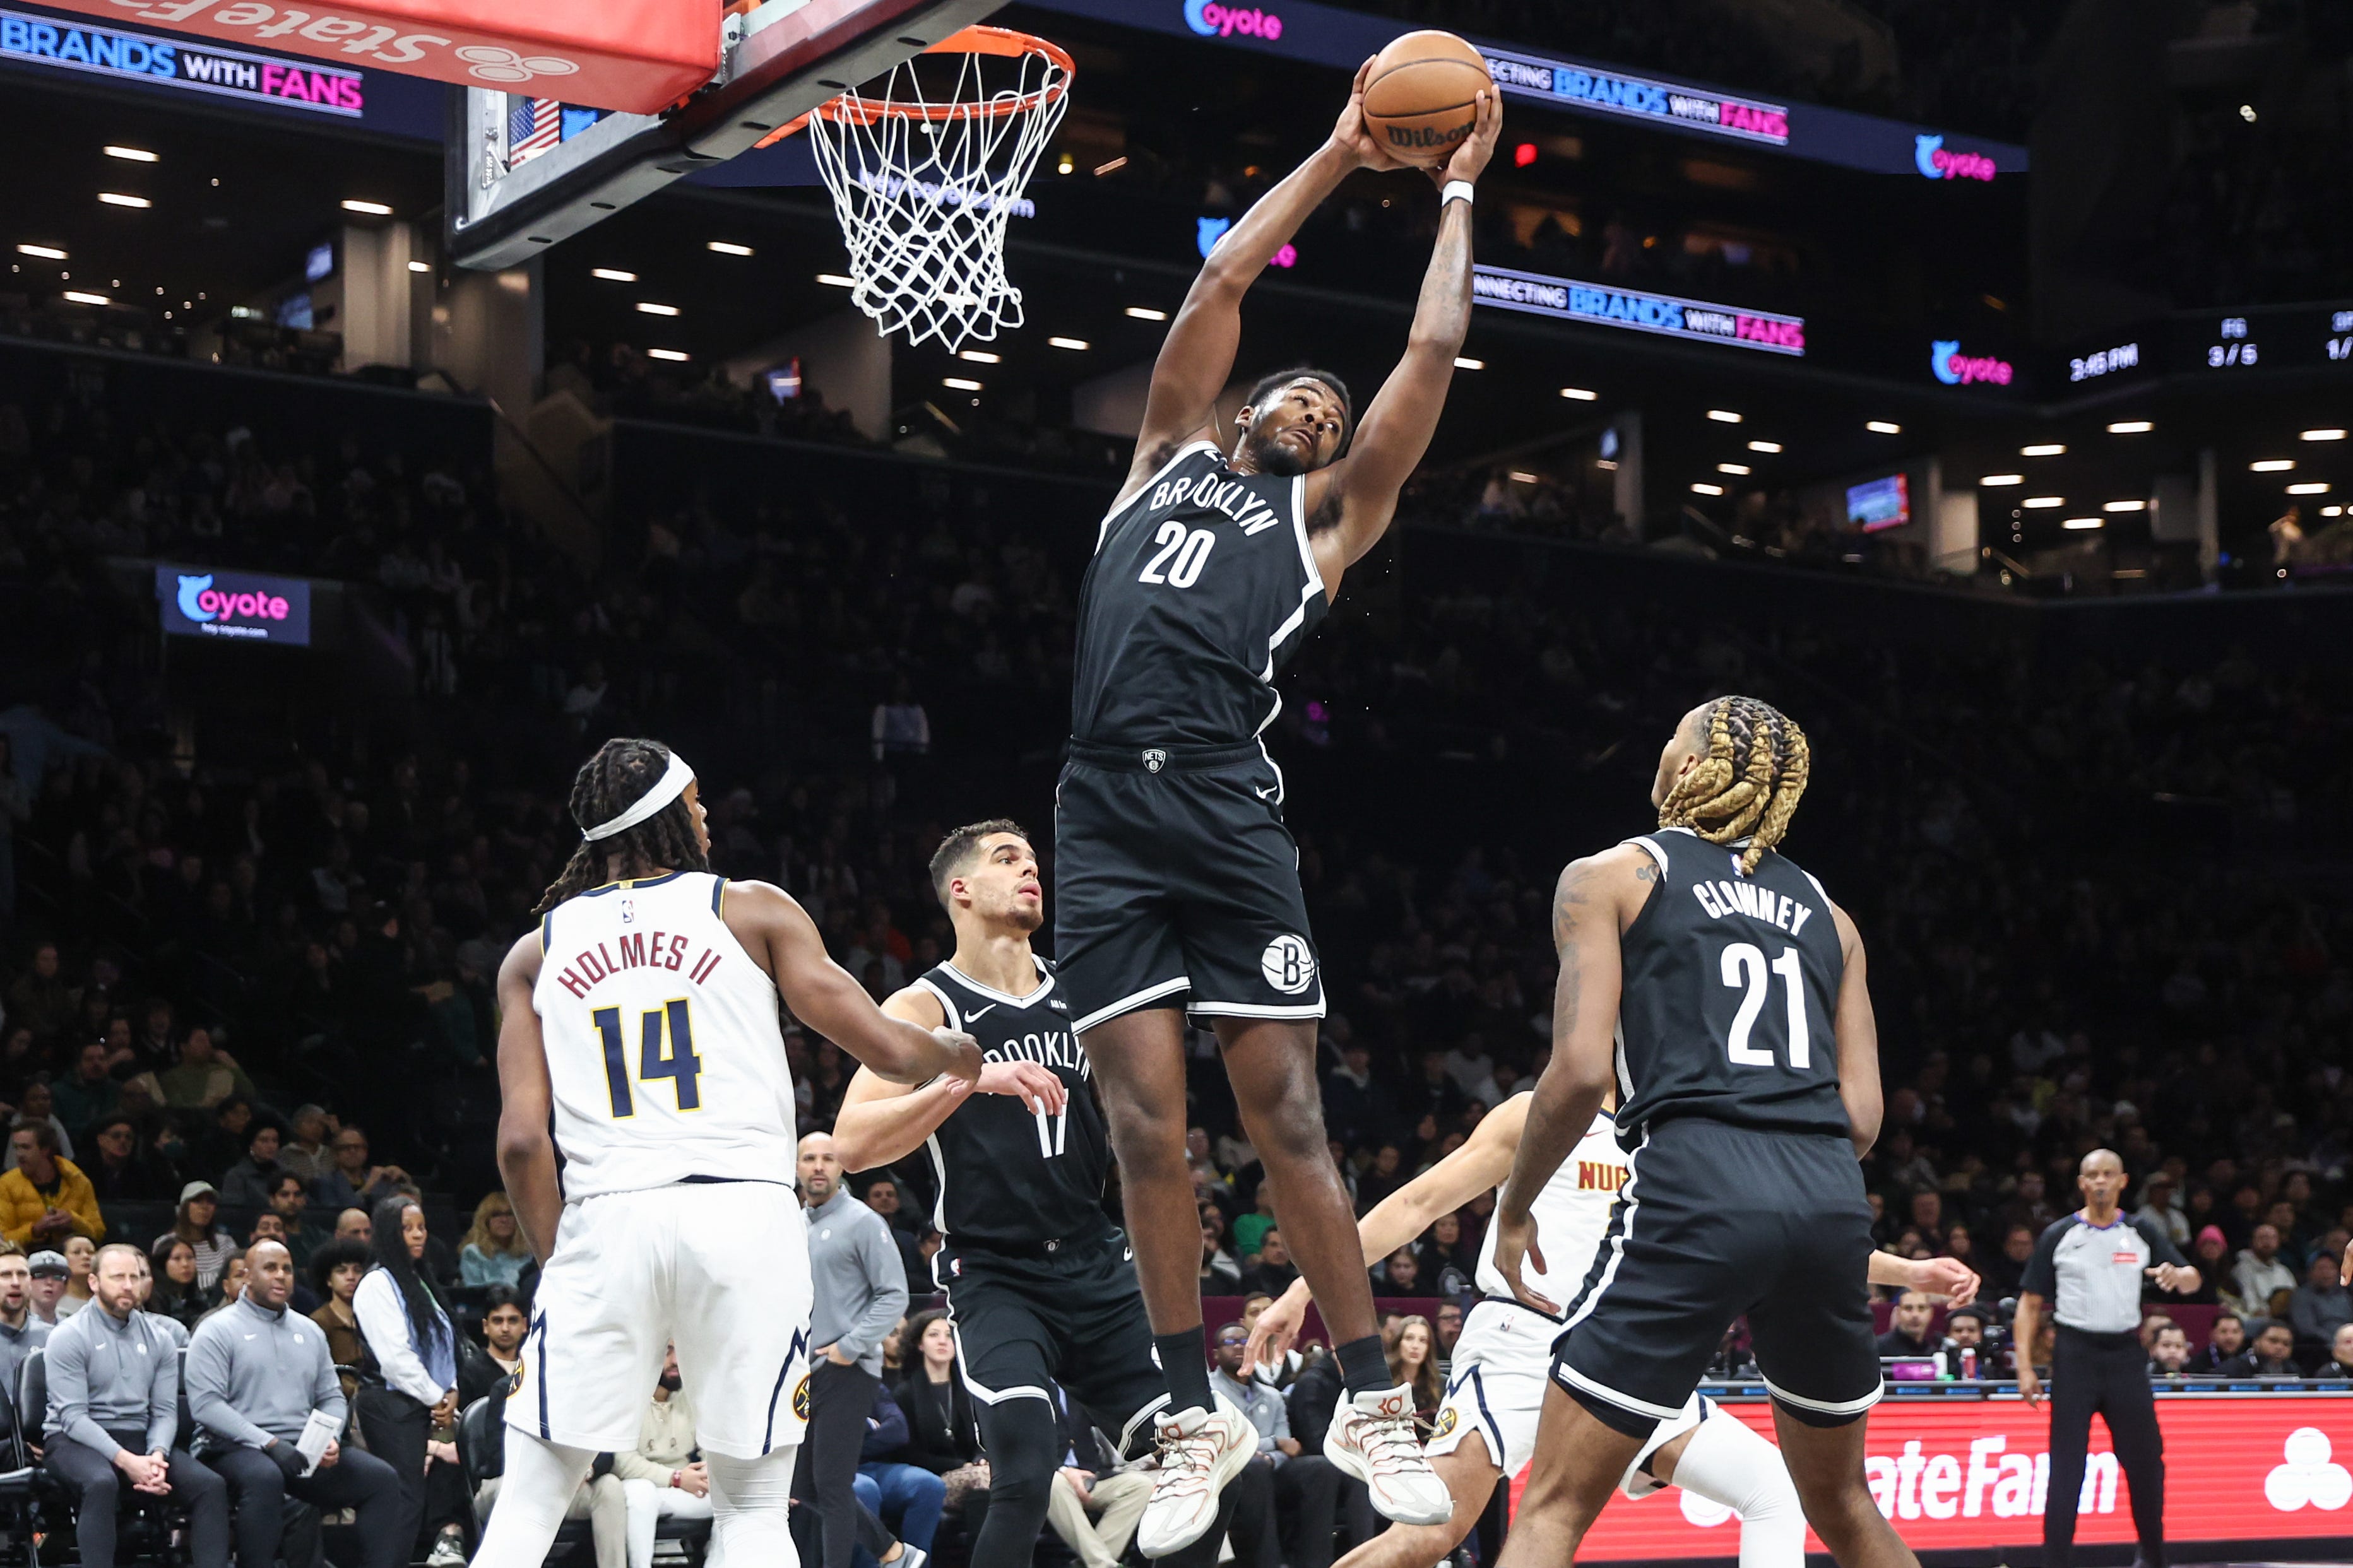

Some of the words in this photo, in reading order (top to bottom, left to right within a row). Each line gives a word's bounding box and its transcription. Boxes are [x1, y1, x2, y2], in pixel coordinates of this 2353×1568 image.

[1, 17, 177, 78] BRANDS
[182, 52, 258, 89] WITH
[261, 63, 364, 110] FANS
[1553, 67, 1668, 115] BRANDS
[1669, 95, 1720, 124] WITH
[1719, 101, 1789, 138] FANS
[1568, 286, 1685, 330] BRANDS
[1685, 309, 1736, 337] WITH
[1736, 314, 1806, 348] FANS
[1149, 473, 1279, 537] BROKLYN
[1138, 520, 1216, 589] 20
[177, 573, 290, 622] Coyote
[1144, 751, 1164, 762] NETS
[1692, 880, 1812, 936] CLOWNEY
[557, 931, 689, 1000] HOLMES
[1283, 943, 1300, 986] B
[1720, 942, 1811, 1069] 21
[590, 996, 703, 1120] 14
